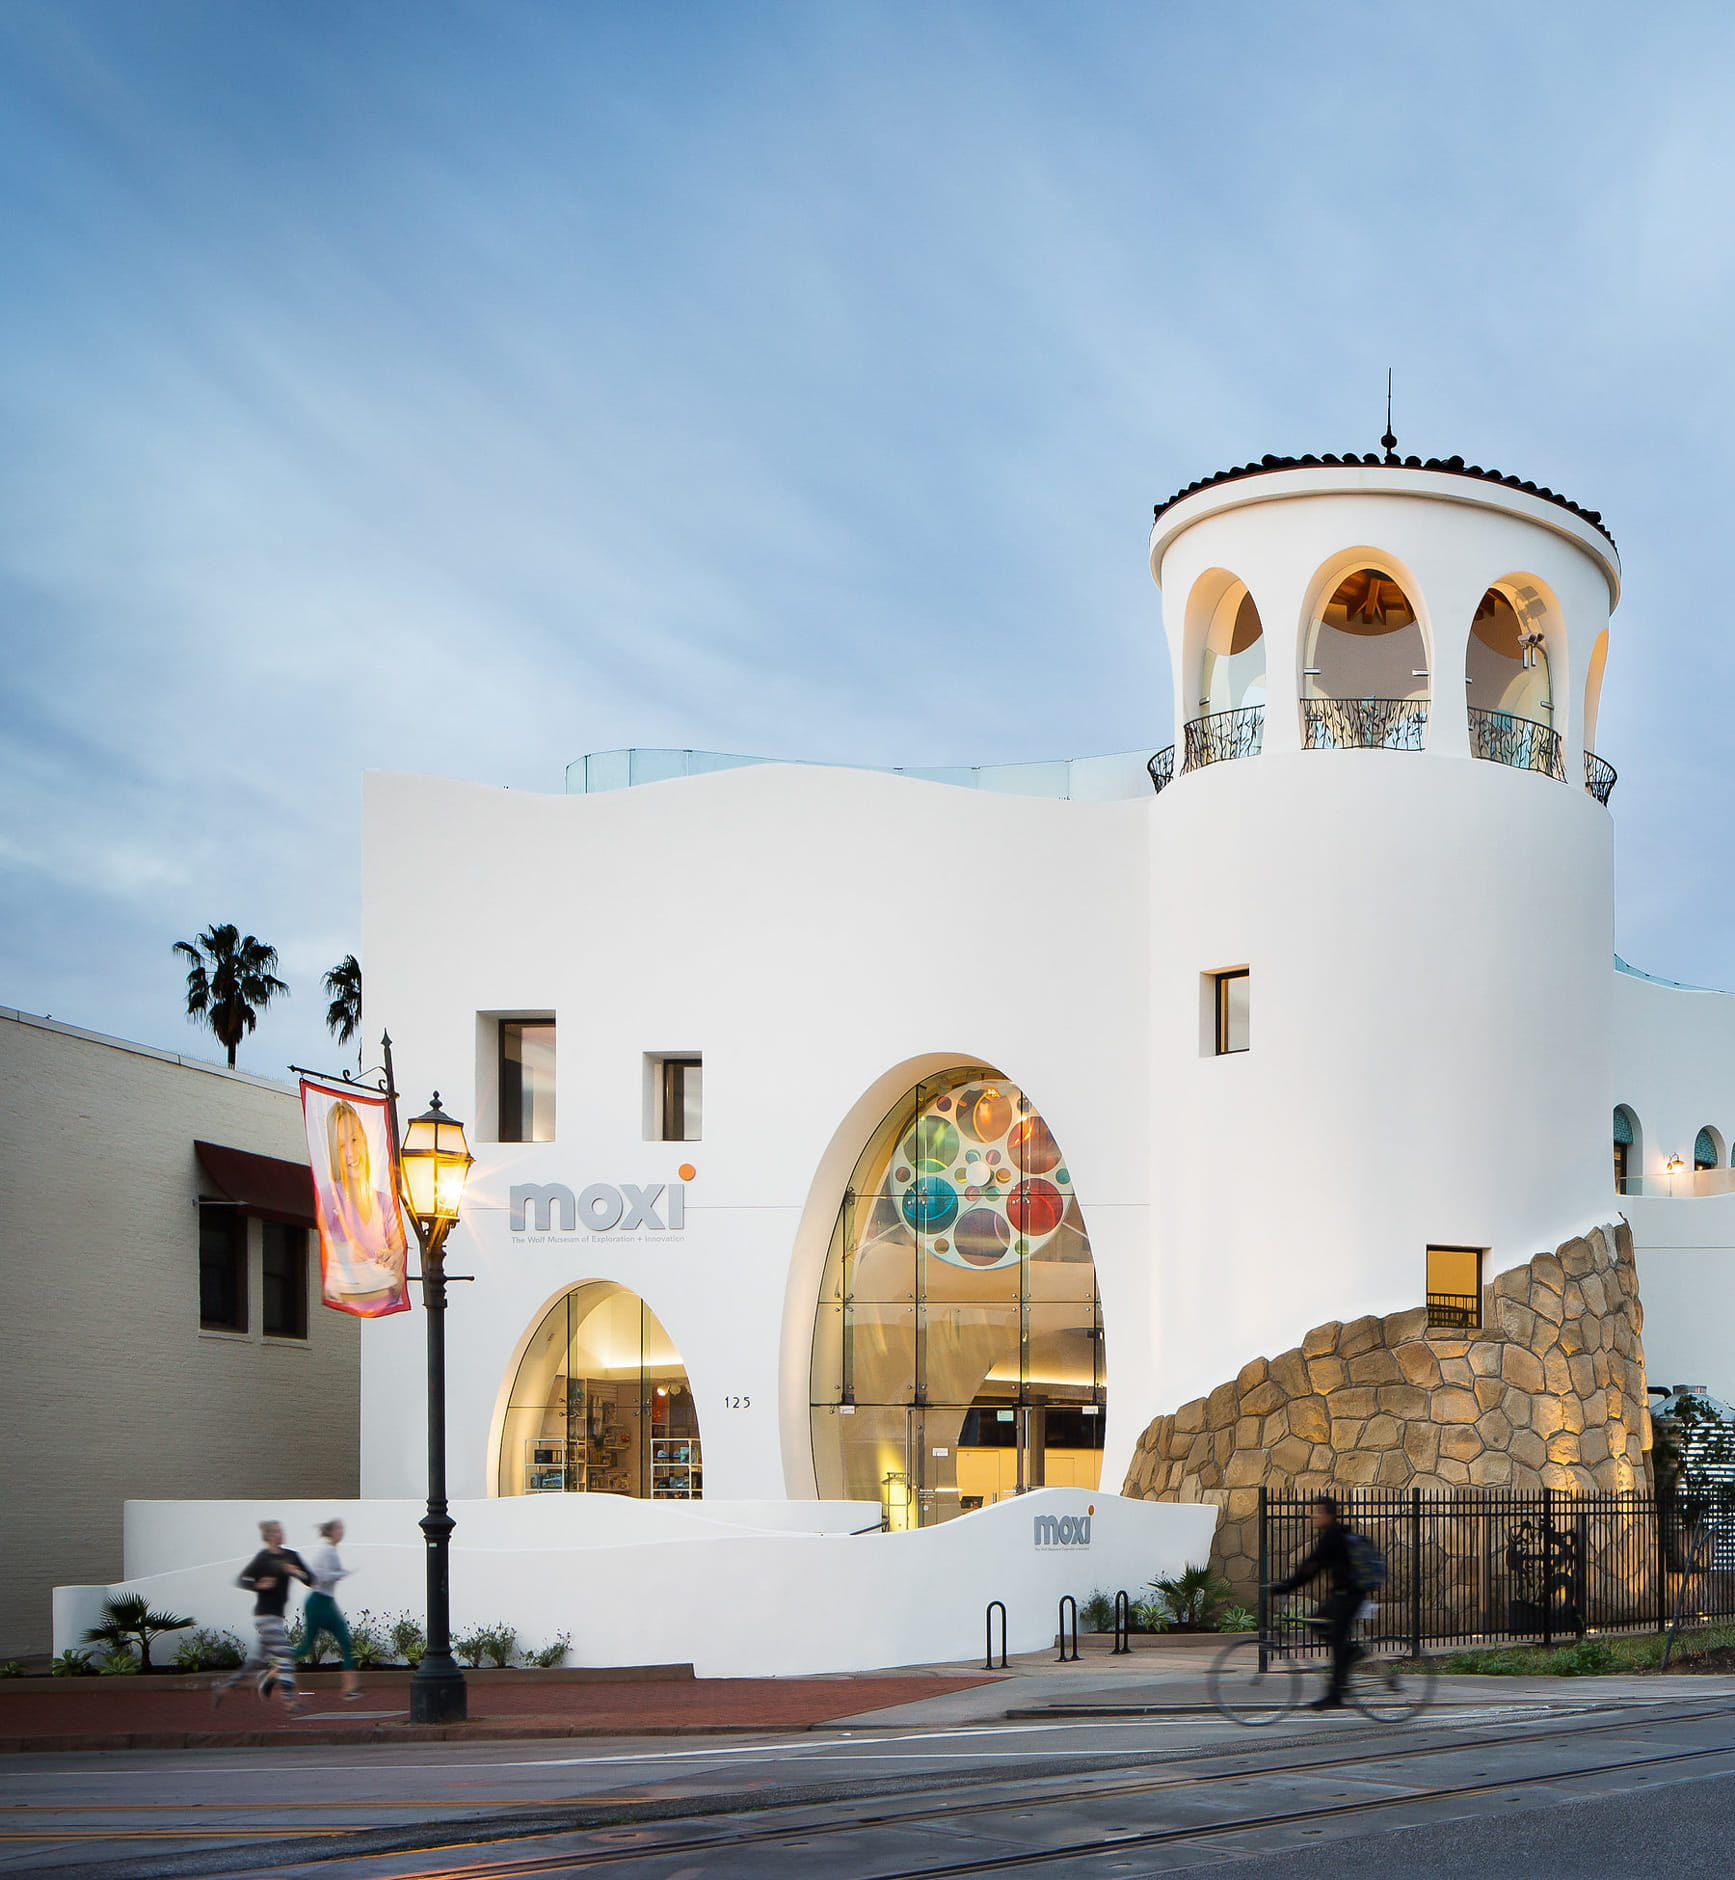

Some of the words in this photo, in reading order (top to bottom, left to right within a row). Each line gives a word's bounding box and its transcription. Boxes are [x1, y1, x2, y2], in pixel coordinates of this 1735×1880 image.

[510, 1163, 696, 1231] moxi
[512, 1236, 525, 1244] The
[527, 1236, 545, 1244] Wolf
[548, 1236, 579, 1244] Museum
[581, 1235, 589, 1243] of
[591, 1235, 635, 1245] Exploration
[645, 1235, 685, 1243] Innovation
[725, 1396, 750, 1408] 125
[1034, 1505, 1094, 1545] moxi
